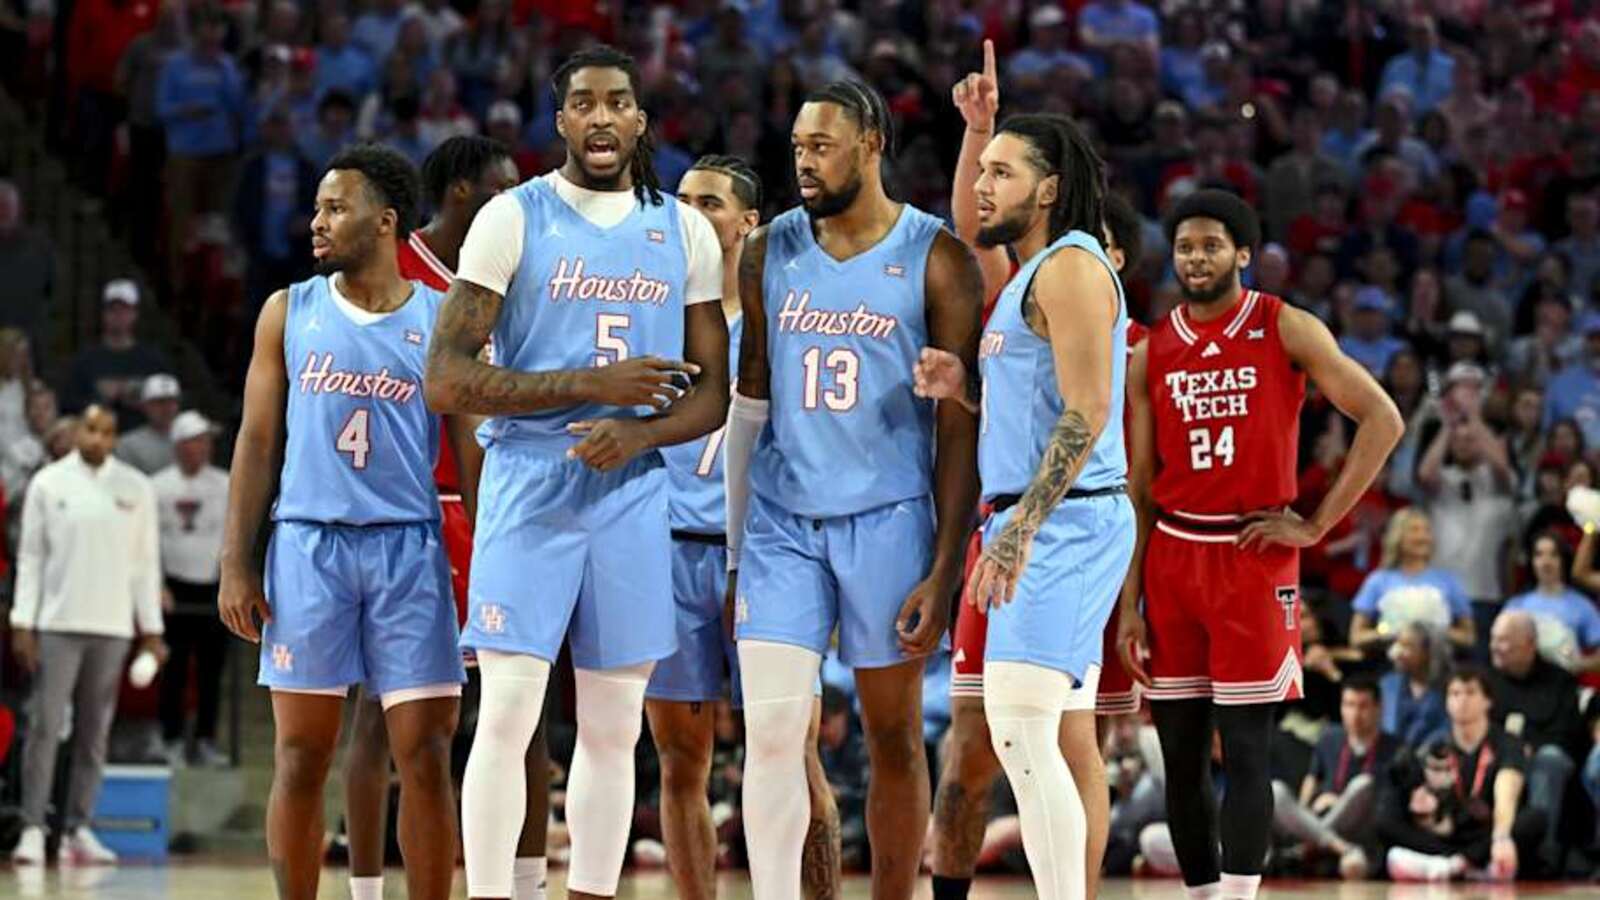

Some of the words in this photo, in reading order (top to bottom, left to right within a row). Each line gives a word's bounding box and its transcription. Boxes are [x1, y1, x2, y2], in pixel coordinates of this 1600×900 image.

[550, 256, 671, 308] Houston
[592, 312, 632, 368] 5
[777, 289, 897, 339] Houston
[299, 352, 417, 404] Houston
[801, 346, 861, 412] 13
[1165, 366, 1257, 398] TEXAS
[1175, 393, 1248, 422] TECH
[336, 408, 371, 471] 4
[1188, 425, 1235, 470] 24
